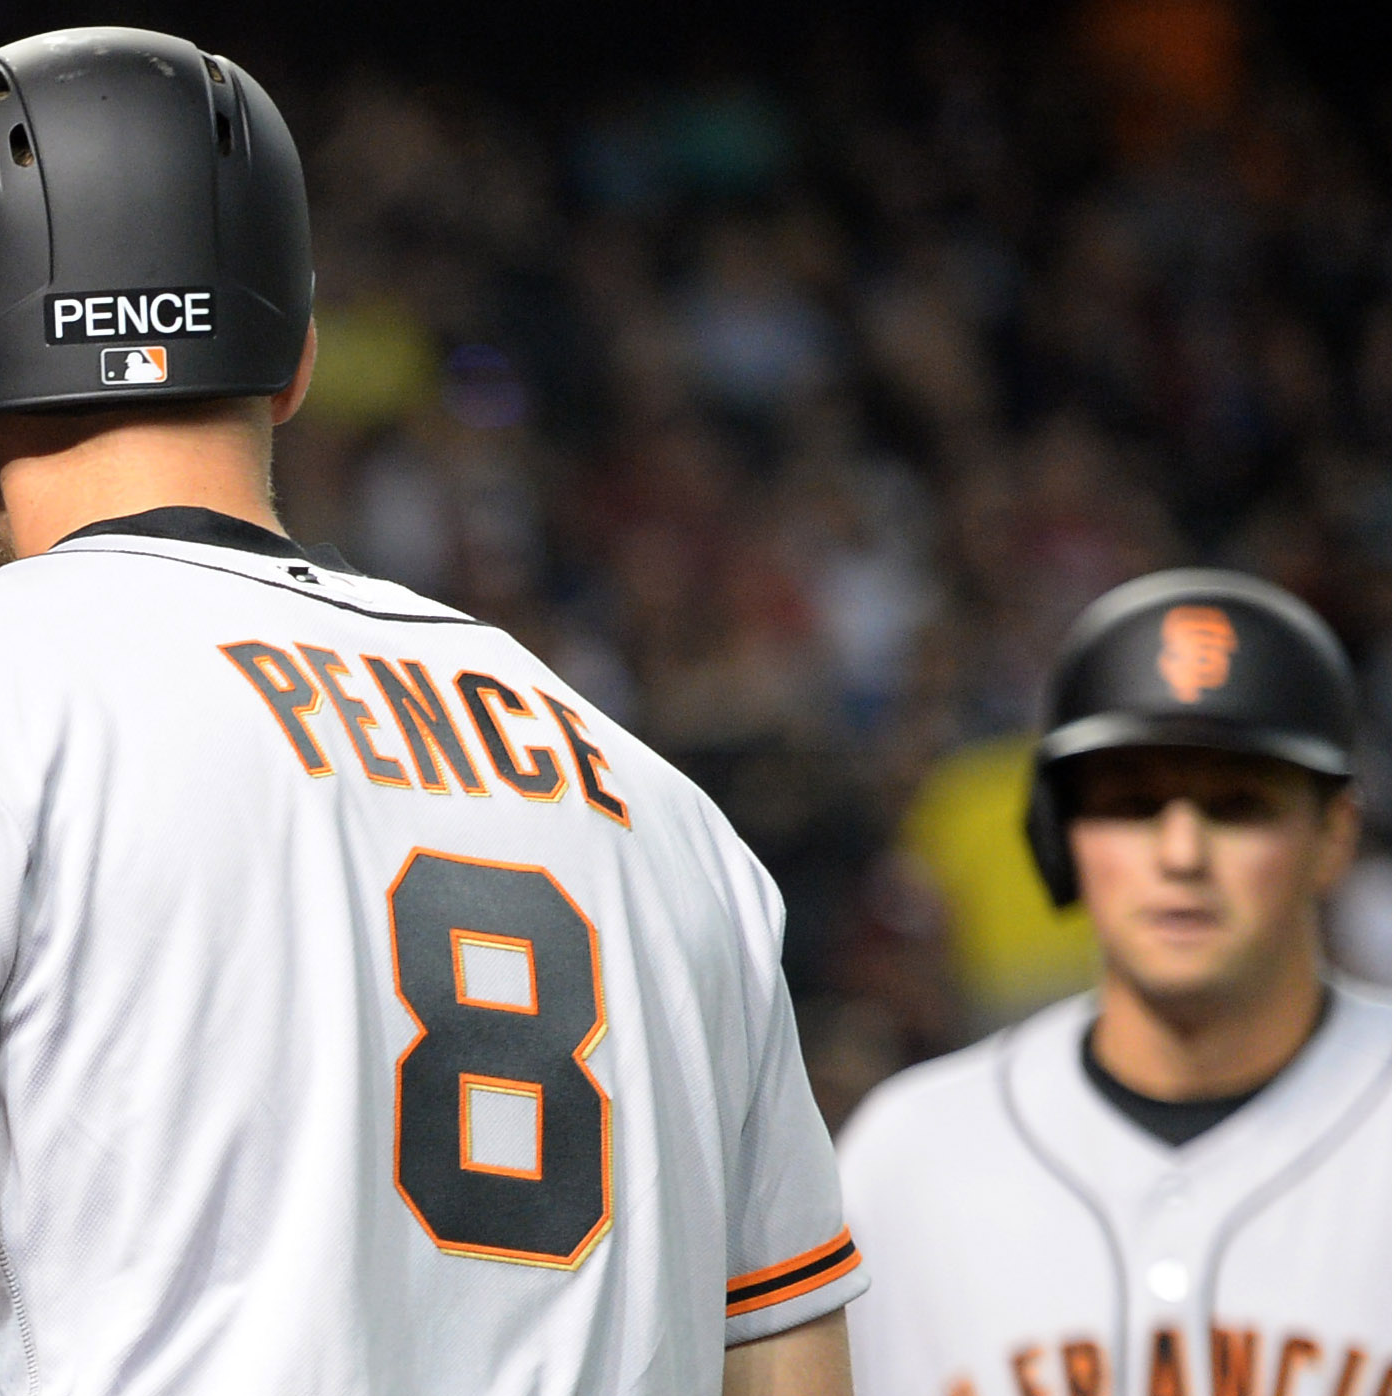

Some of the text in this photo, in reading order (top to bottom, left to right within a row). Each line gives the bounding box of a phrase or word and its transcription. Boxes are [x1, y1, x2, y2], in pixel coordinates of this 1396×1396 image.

[53, 292, 213, 340] PENCE
[216, 638, 632, 831] PENCE
[386, 845, 614, 1271] 8
